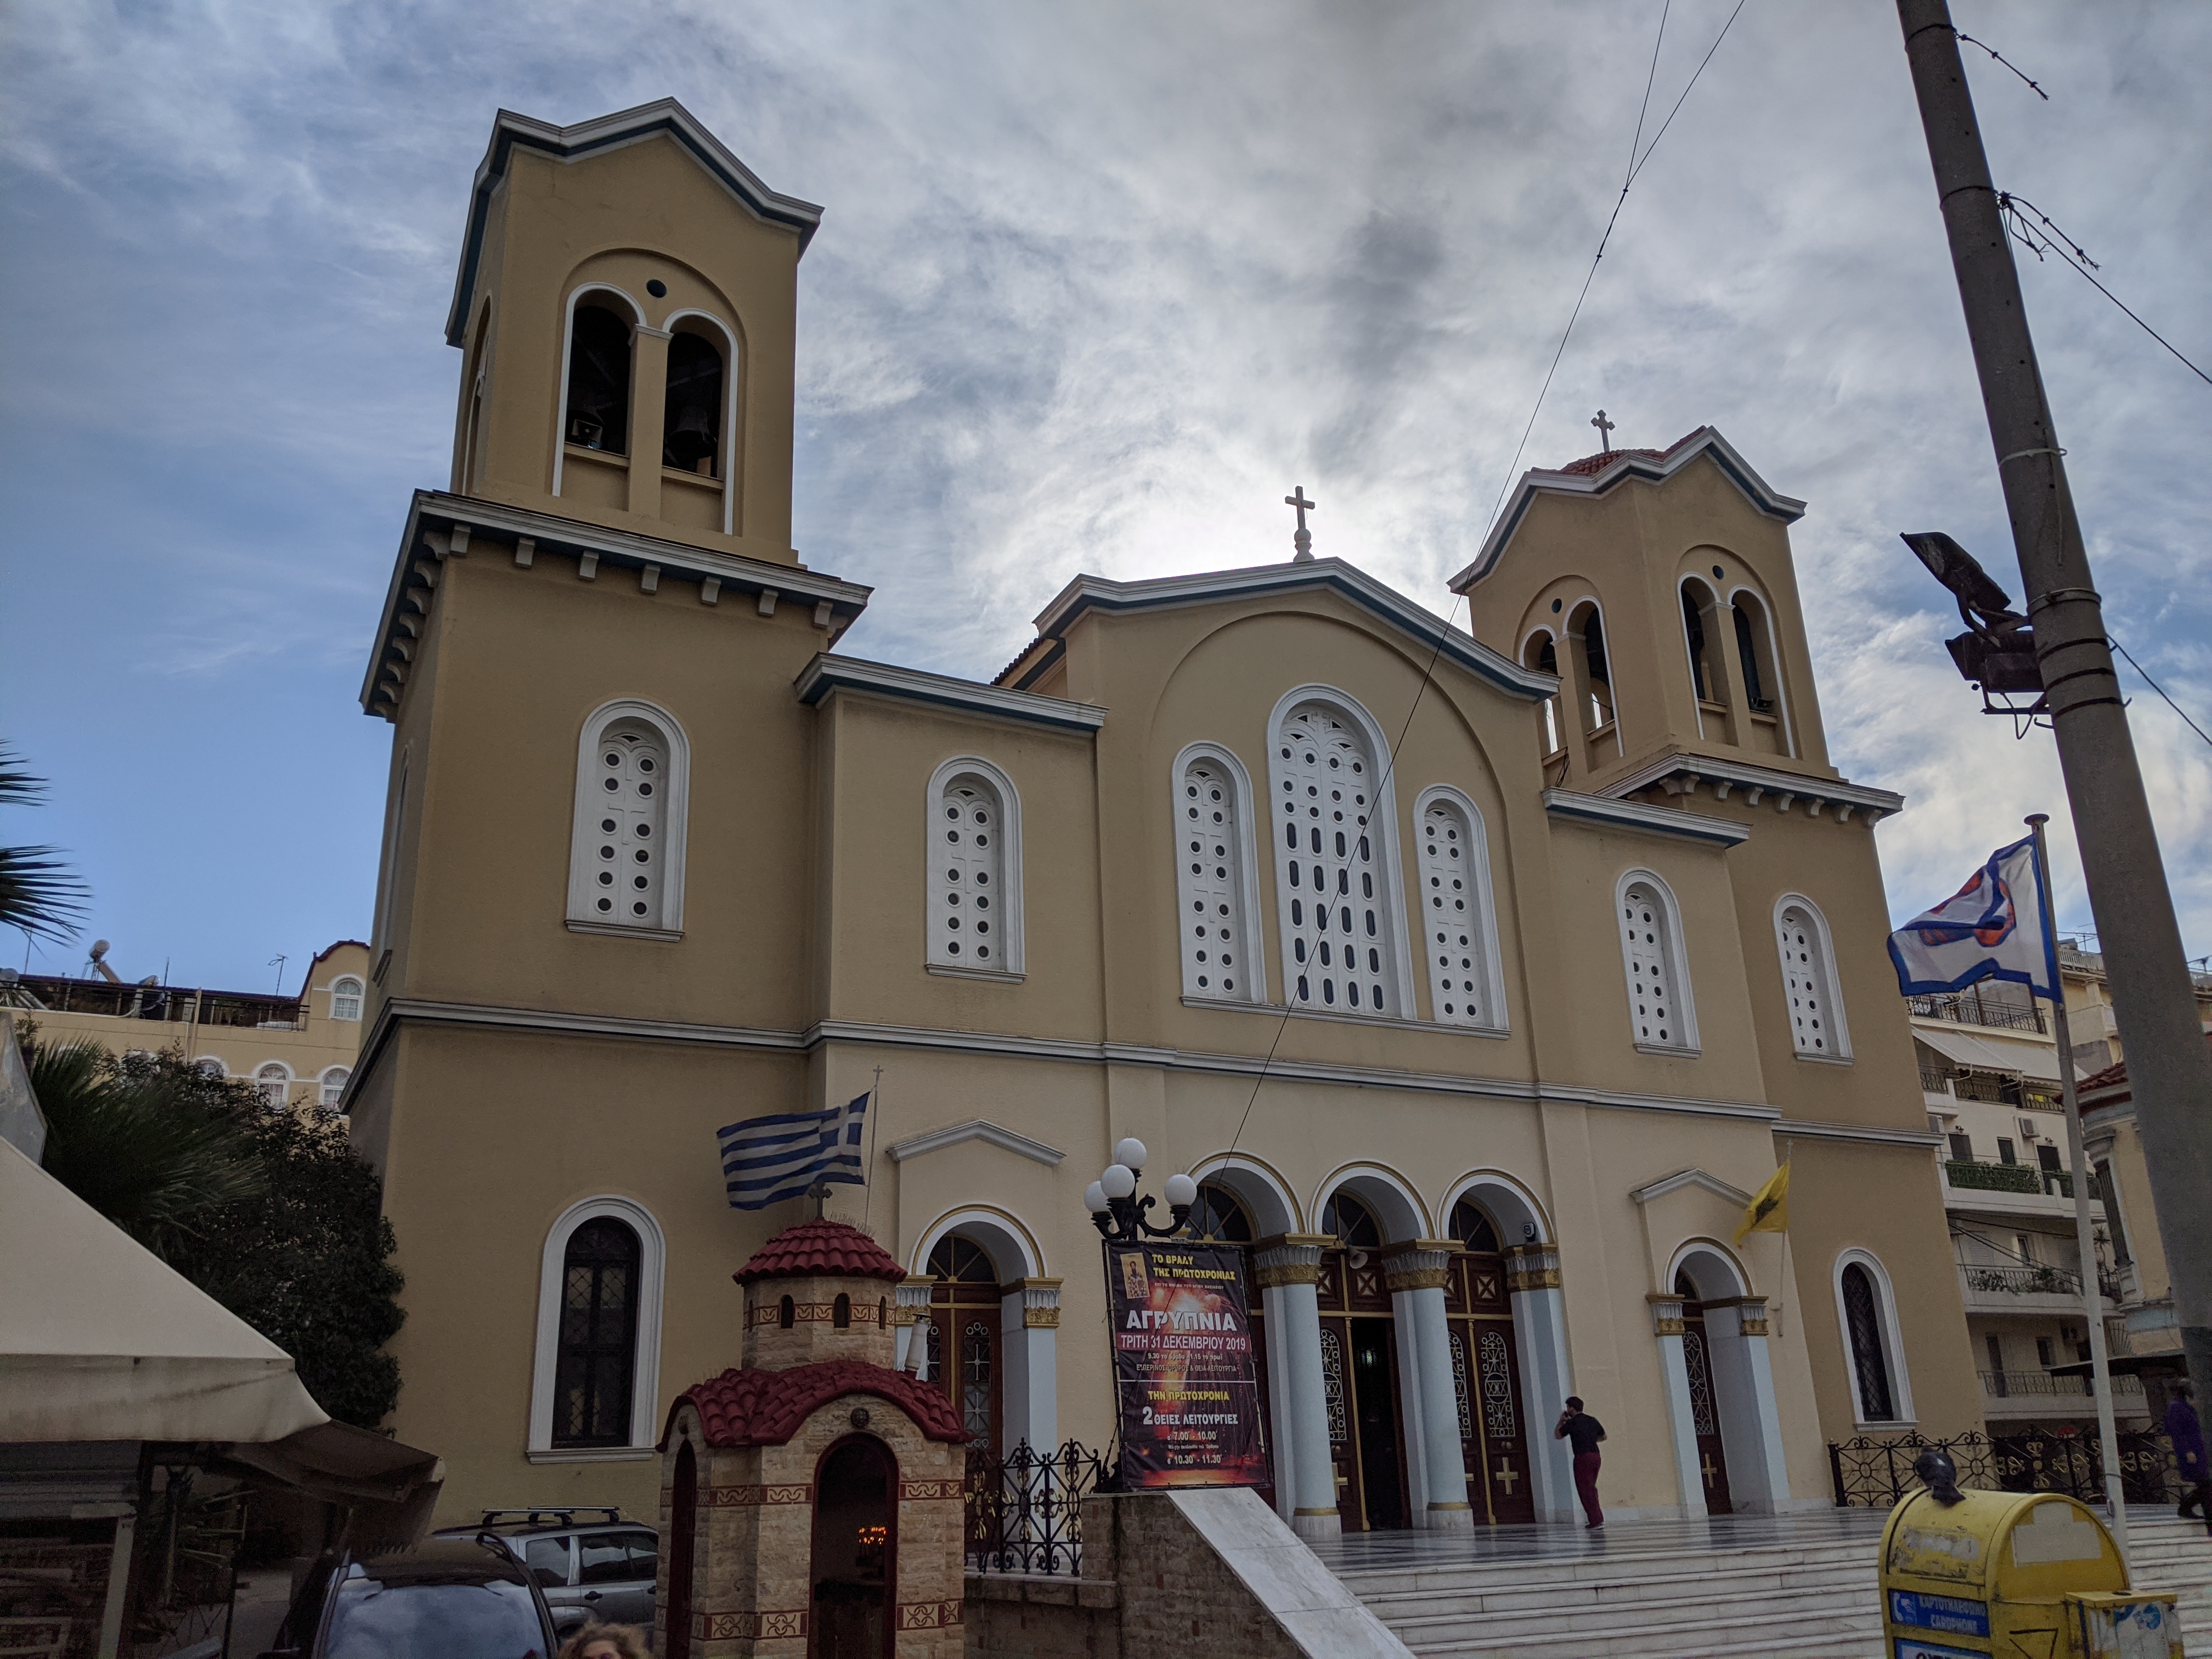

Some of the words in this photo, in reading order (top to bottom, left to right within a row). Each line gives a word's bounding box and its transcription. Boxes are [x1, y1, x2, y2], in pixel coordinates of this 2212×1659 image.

[1152, 1254, 1164, 1263] ΤΟ
[1166, 1255, 1194, 1265] ΒΡΑΔΥ
[1153, 1267, 1170, 1277] ΤΗΣ
[1172, 1268, 1235, 1280] ΠΡΩΤΟΧΡΟΝΙΑΣ
[1126, 1310, 1237, 1331] ΑΓΡΥΠΝΙΑ
[1121, 1335, 1148, 1348] ΤΡΙΤΗ
[1151, 1335, 1160, 1348] 31
[1163, 1336, 1224, 1350] ΔΕΚΕΜΒΡΙΟΥ
[1226, 1338, 1246, 1350] 2019
[1148, 1391, 1166, 1400] ΤΗΝ
[1169, 1391, 1230, 1401] ΠΡΩΤΟΧΡΟΝΙΑ
[1142, 1406, 1153, 1425] 2
[1154, 1414, 1180, 1425] ΘΕΙΕΣ
[1183, 1414, 1238, 1425] ΛΕΙΤΟΥΡΓΙΕΣ
